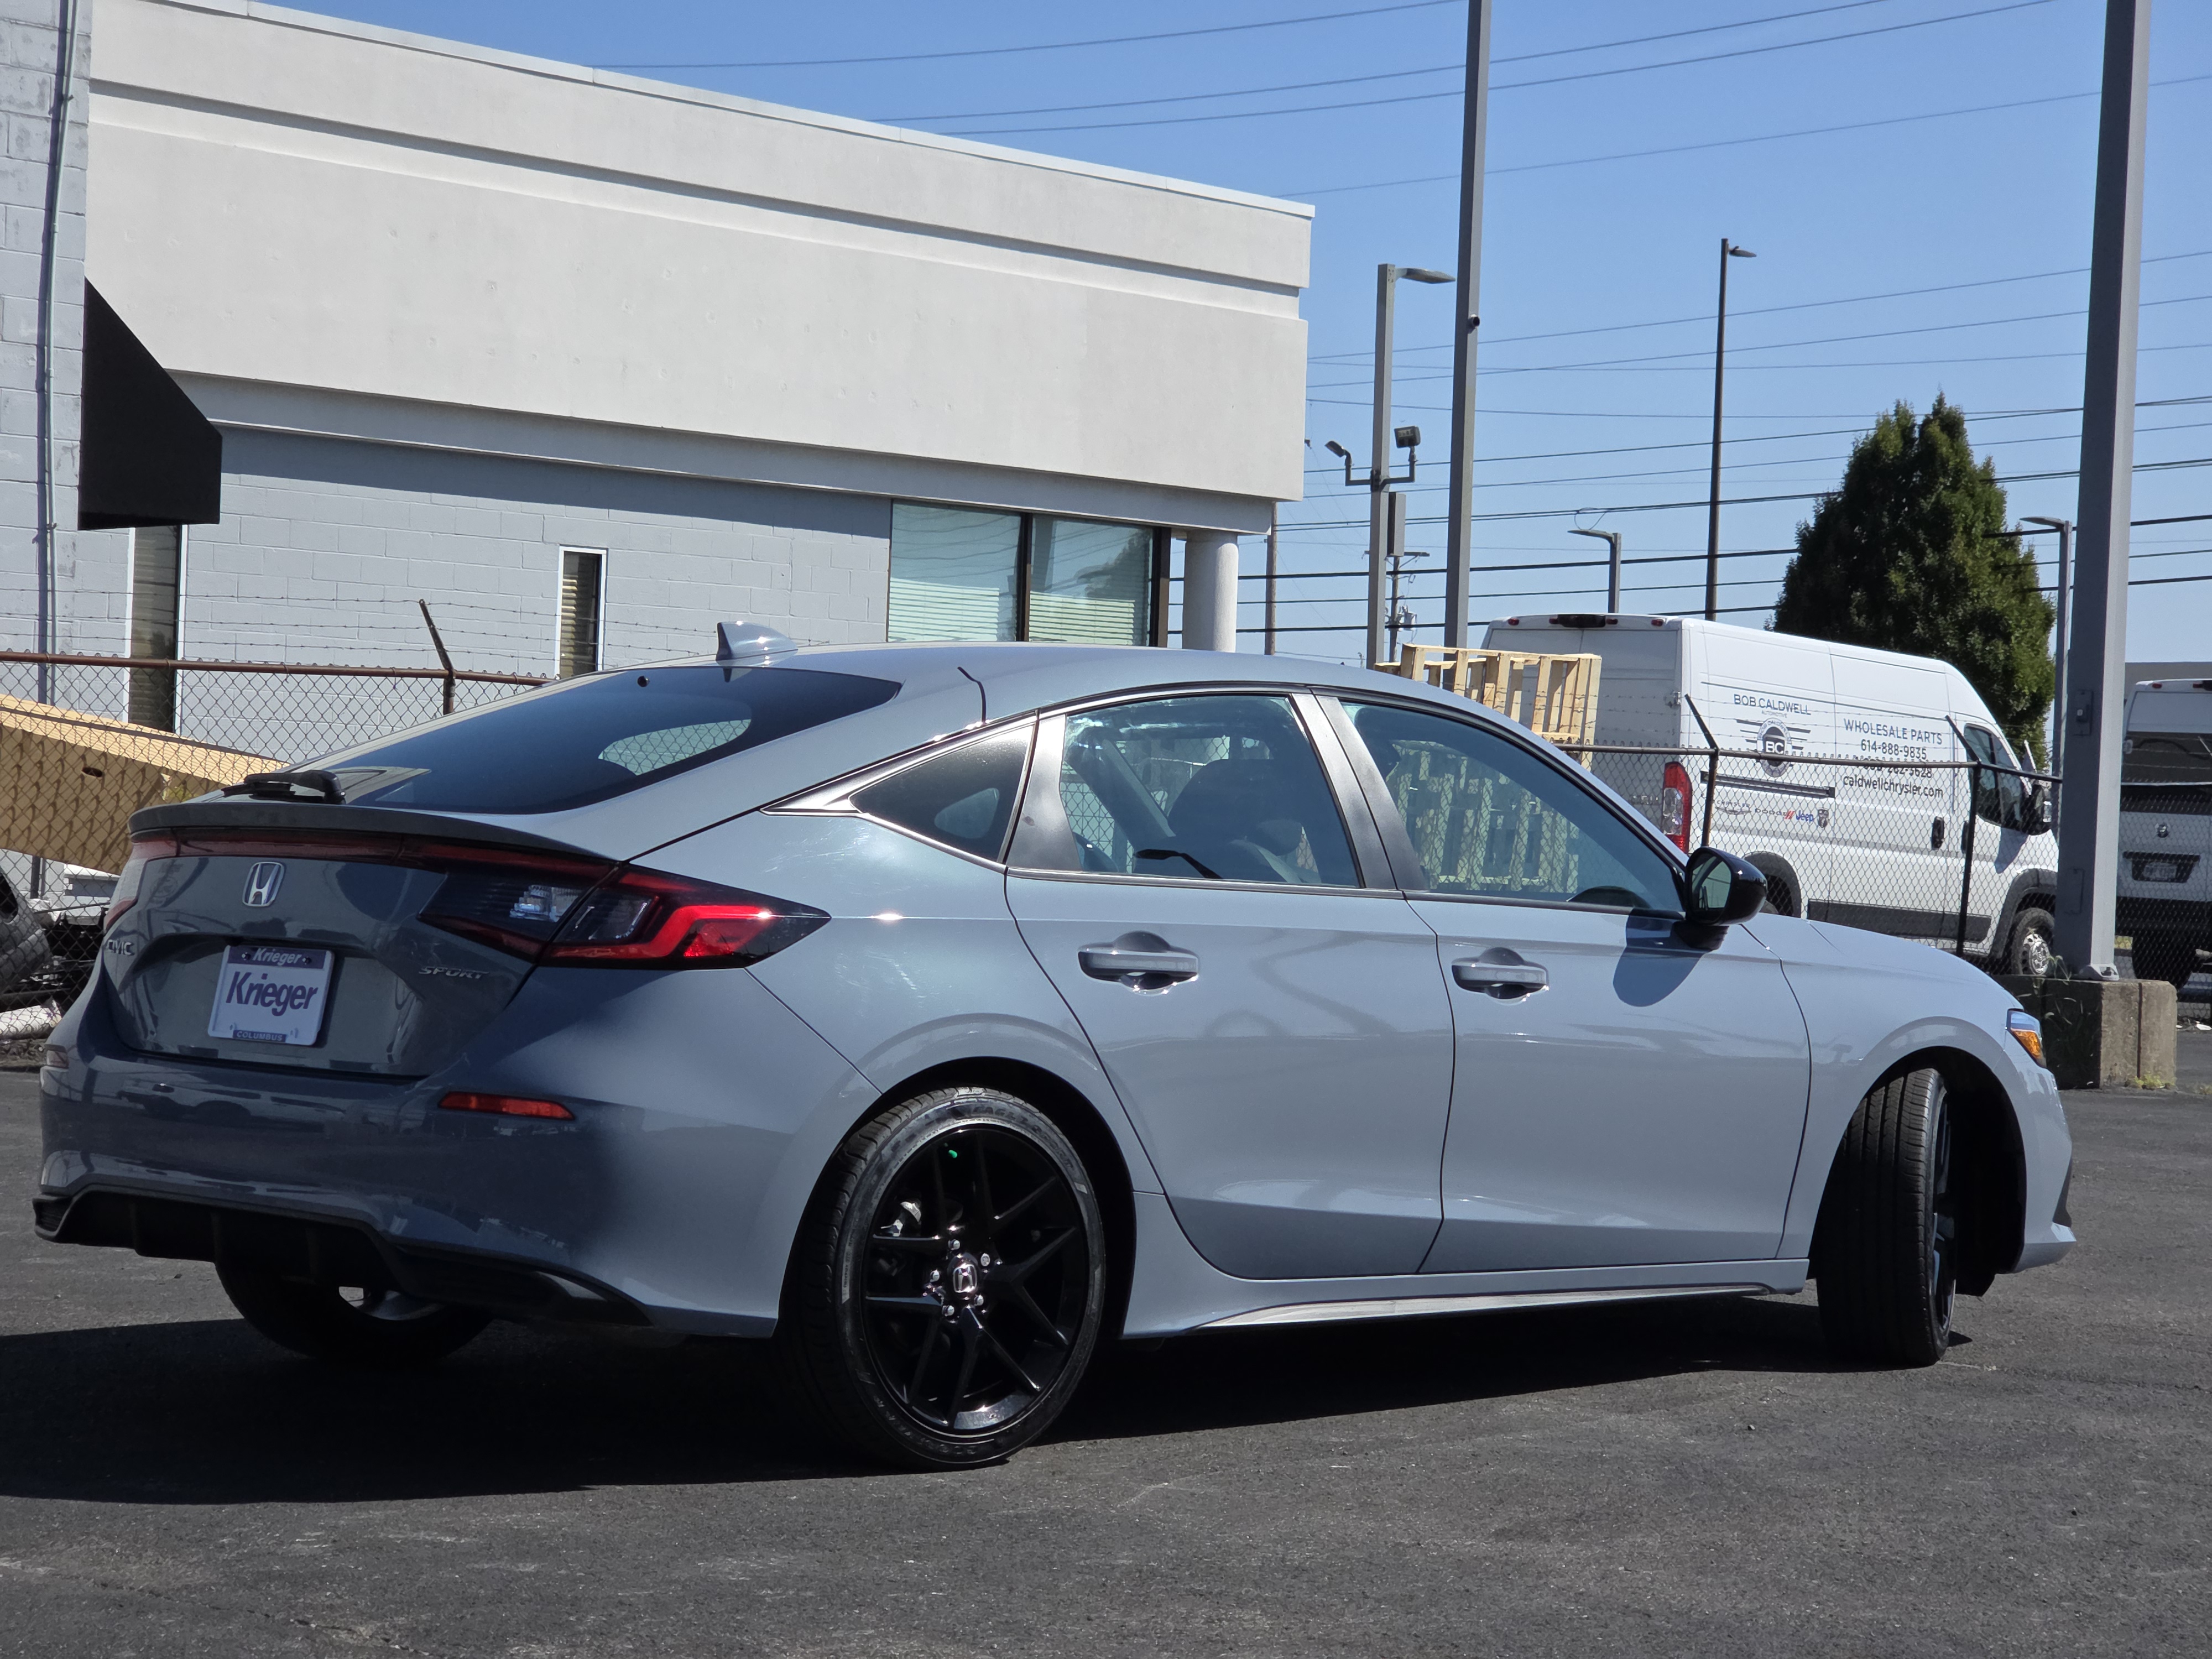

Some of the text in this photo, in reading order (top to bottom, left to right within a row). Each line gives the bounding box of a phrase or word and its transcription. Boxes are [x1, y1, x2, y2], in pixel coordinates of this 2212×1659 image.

[1734, 694, 1811, 715] BOB CALDWELL
[1844, 718, 1942, 745] WHOLESALE PARTS
[1766, 741, 1784, 754] BC
[1861, 739, 1927, 760] 614-888-9835
[1843, 775, 1943, 797] caldwellchrysler.com
[1796, 810, 1814, 823] Jeep
[252, 948, 302, 966] Krieger
[419, 966, 489, 979] SPORT
[226, 971, 319, 1017] Krieger
[236, 1031, 283, 1041] COLUMBUS
